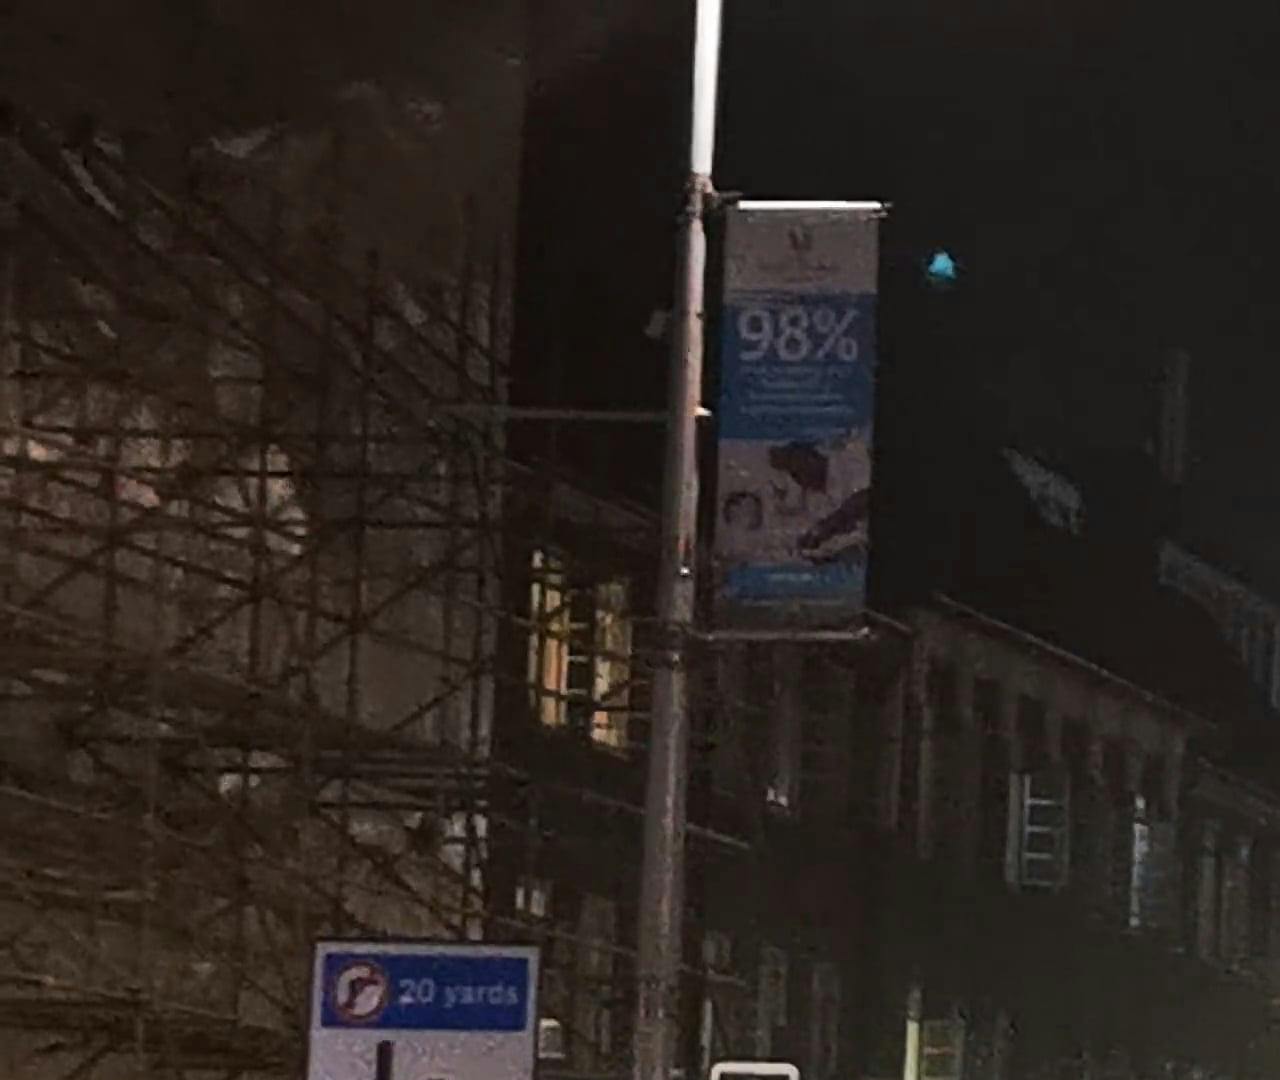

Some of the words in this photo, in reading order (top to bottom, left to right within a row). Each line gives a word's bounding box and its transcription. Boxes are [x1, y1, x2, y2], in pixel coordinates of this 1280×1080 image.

[738, 307, 859, 363] 98%
[400, 977, 434, 1005] 20
[444, 979, 519, 1008] yards
